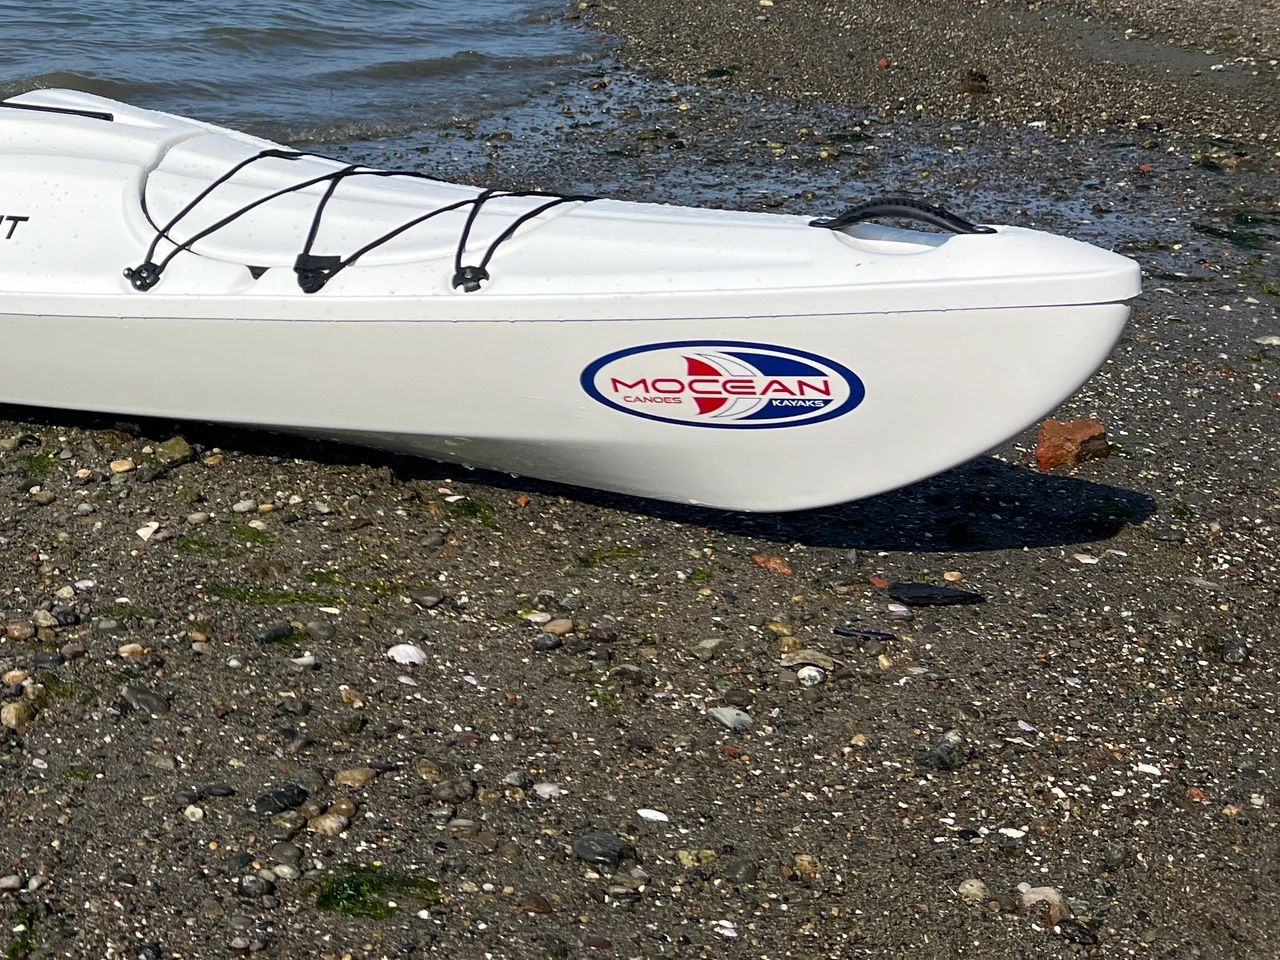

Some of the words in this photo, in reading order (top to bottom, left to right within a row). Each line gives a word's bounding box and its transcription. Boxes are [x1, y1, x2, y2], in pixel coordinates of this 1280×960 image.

[611, 378, 831, 396] MOCEAN
[623, 396, 683, 404] CANOES
[772, 399, 825, 407] KAYAKS
